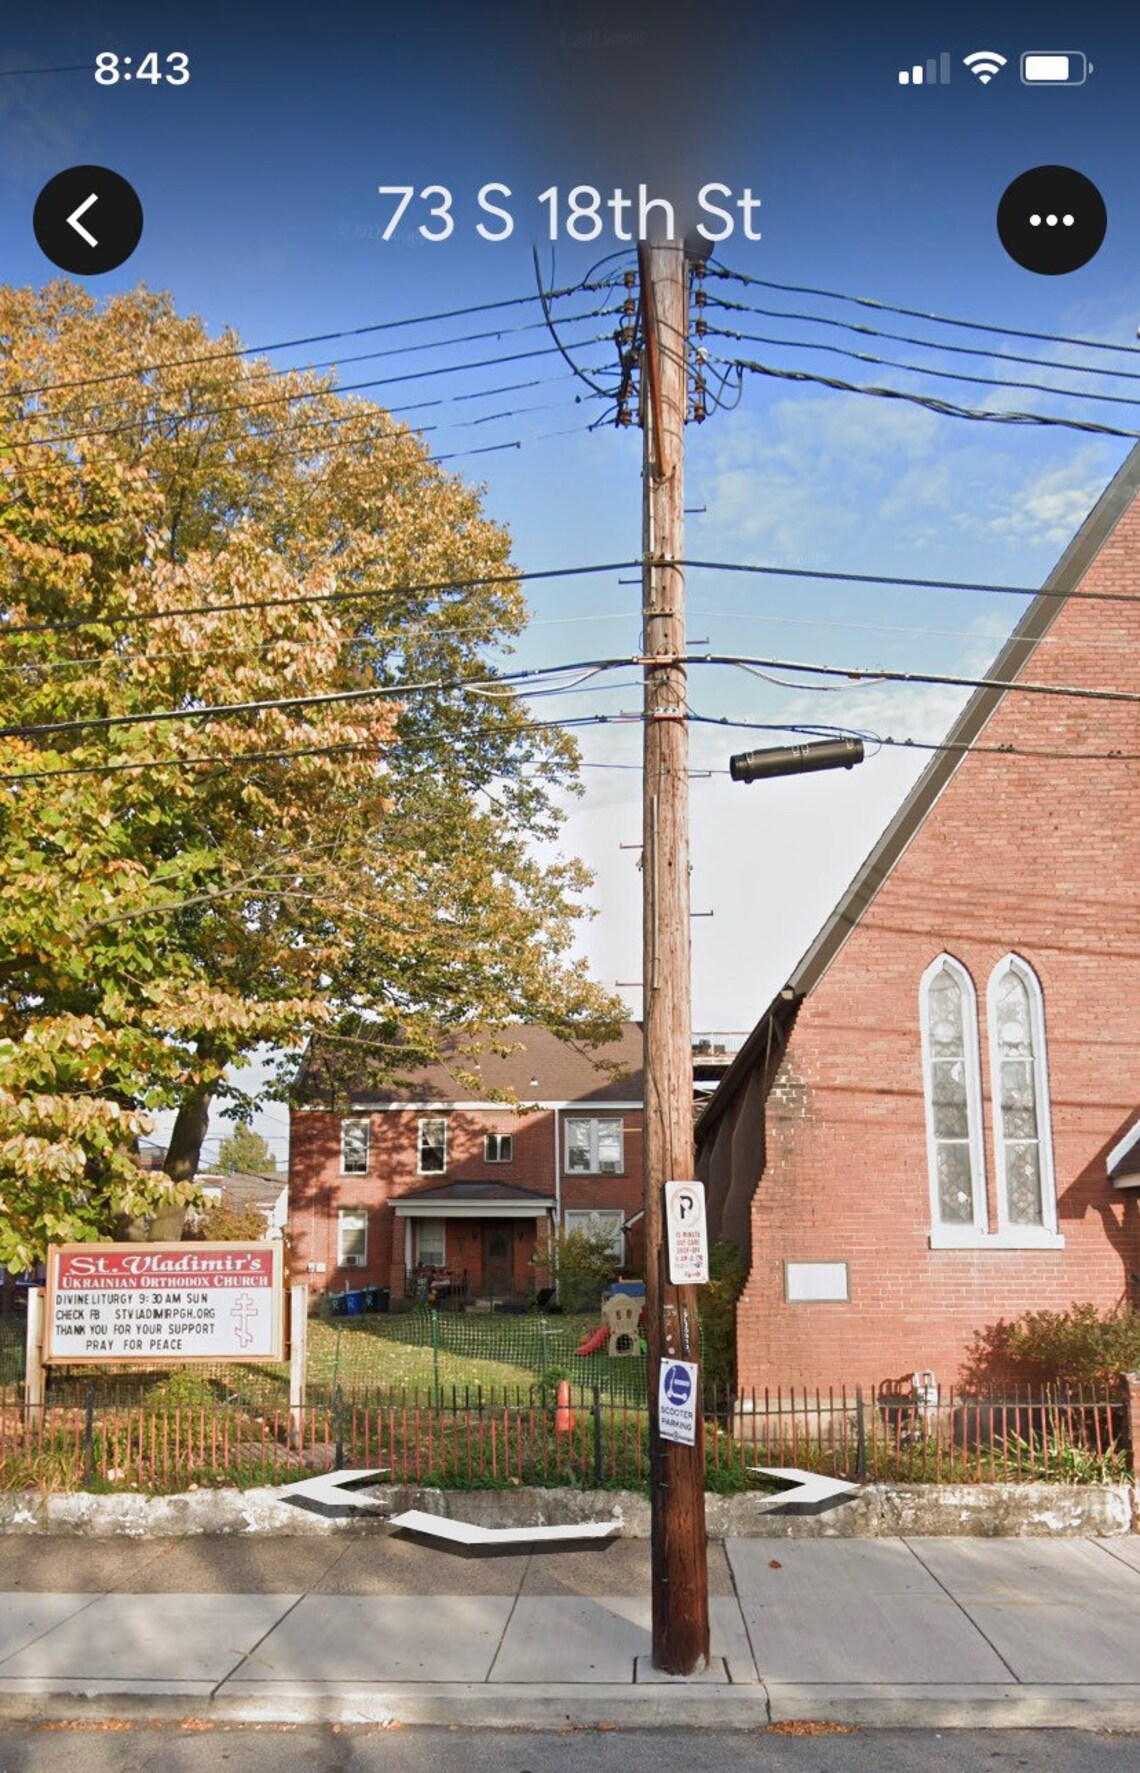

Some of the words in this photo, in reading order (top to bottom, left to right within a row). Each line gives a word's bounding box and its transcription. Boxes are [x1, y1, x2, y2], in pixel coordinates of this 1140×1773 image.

[68, 1256, 118, 1276] St.
[122, 1254, 261, 1275] Vladimir's
[62, 1276, 137, 1288] UKRAINIAN
[140, 1275, 210, 1288] ORTHODOX
[213, 1274, 268, 1287] CHURCH
[165, 1293, 181, 1304] AM
[187, 1293, 208, 1303] SUN
[56, 1309, 84, 1320] CHECK
[90, 1309, 100, 1320] FB
[56, 1325, 86, 1335] THANK
[90, 1325, 108, 1335] YOU
[113, 1324, 131, 1335] FOR
[136, 1323, 162, 1335] YOUR
[168, 1323, 215, 1335] SUPPORT
[86, 1340, 113, 1350] PRAY
[124, 1340, 143, 1350] FOR
[150, 1339, 182, 1350] PEACE
[660, 1405, 694, 1419] SCOOTER
[661, 1417, 692, 1431] PARKING
